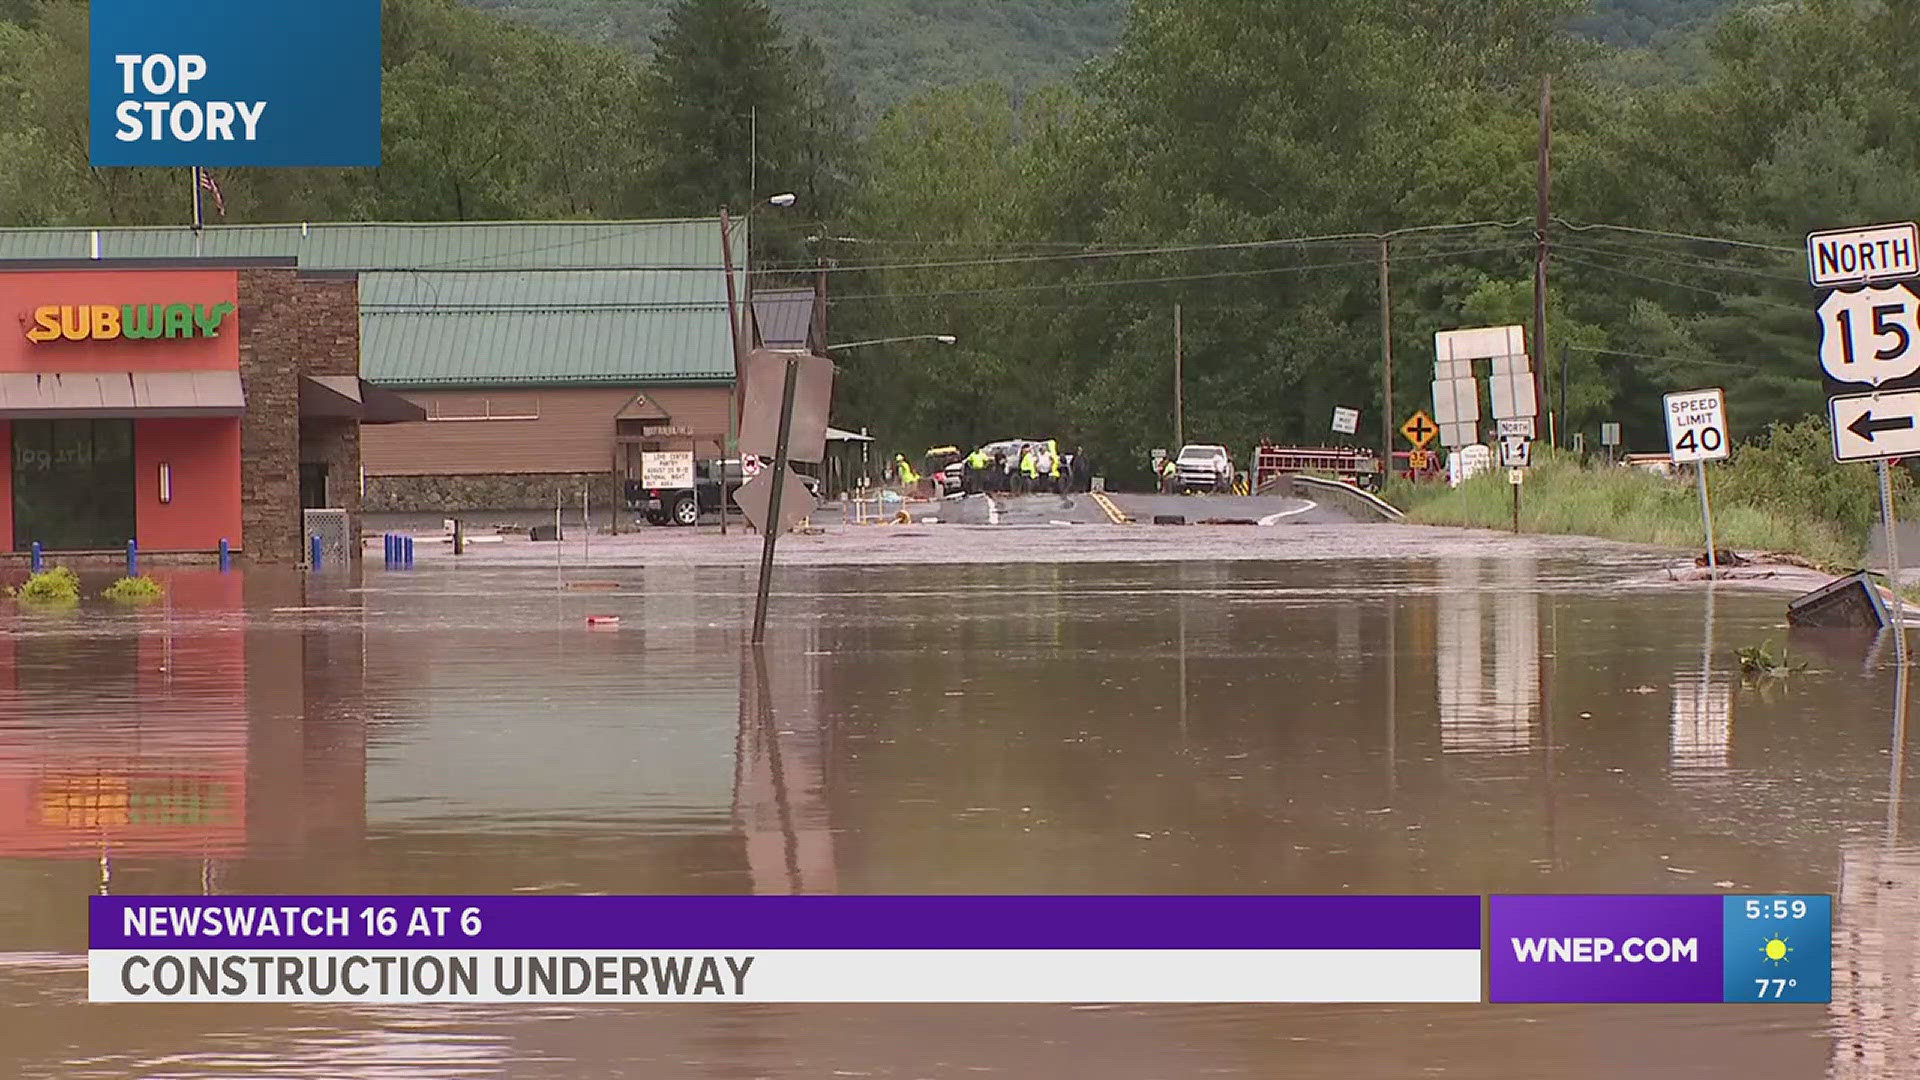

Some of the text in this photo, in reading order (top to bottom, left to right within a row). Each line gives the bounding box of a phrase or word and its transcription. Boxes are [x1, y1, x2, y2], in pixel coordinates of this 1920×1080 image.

[1818, 237, 1910, 276] NORTH
[25, 301, 235, 344] SUBWAY
[1836, 303, 1910, 364] 15
[1671, 399, 1718, 414] SPEED
[1502, 423, 1528, 432] NORTH
[1677, 412, 1713, 427] LIMIT
[1675, 427, 1722, 453] 40
[1411, 451, 1425, 461] 35
[1504, 443, 1525, 459] 14
